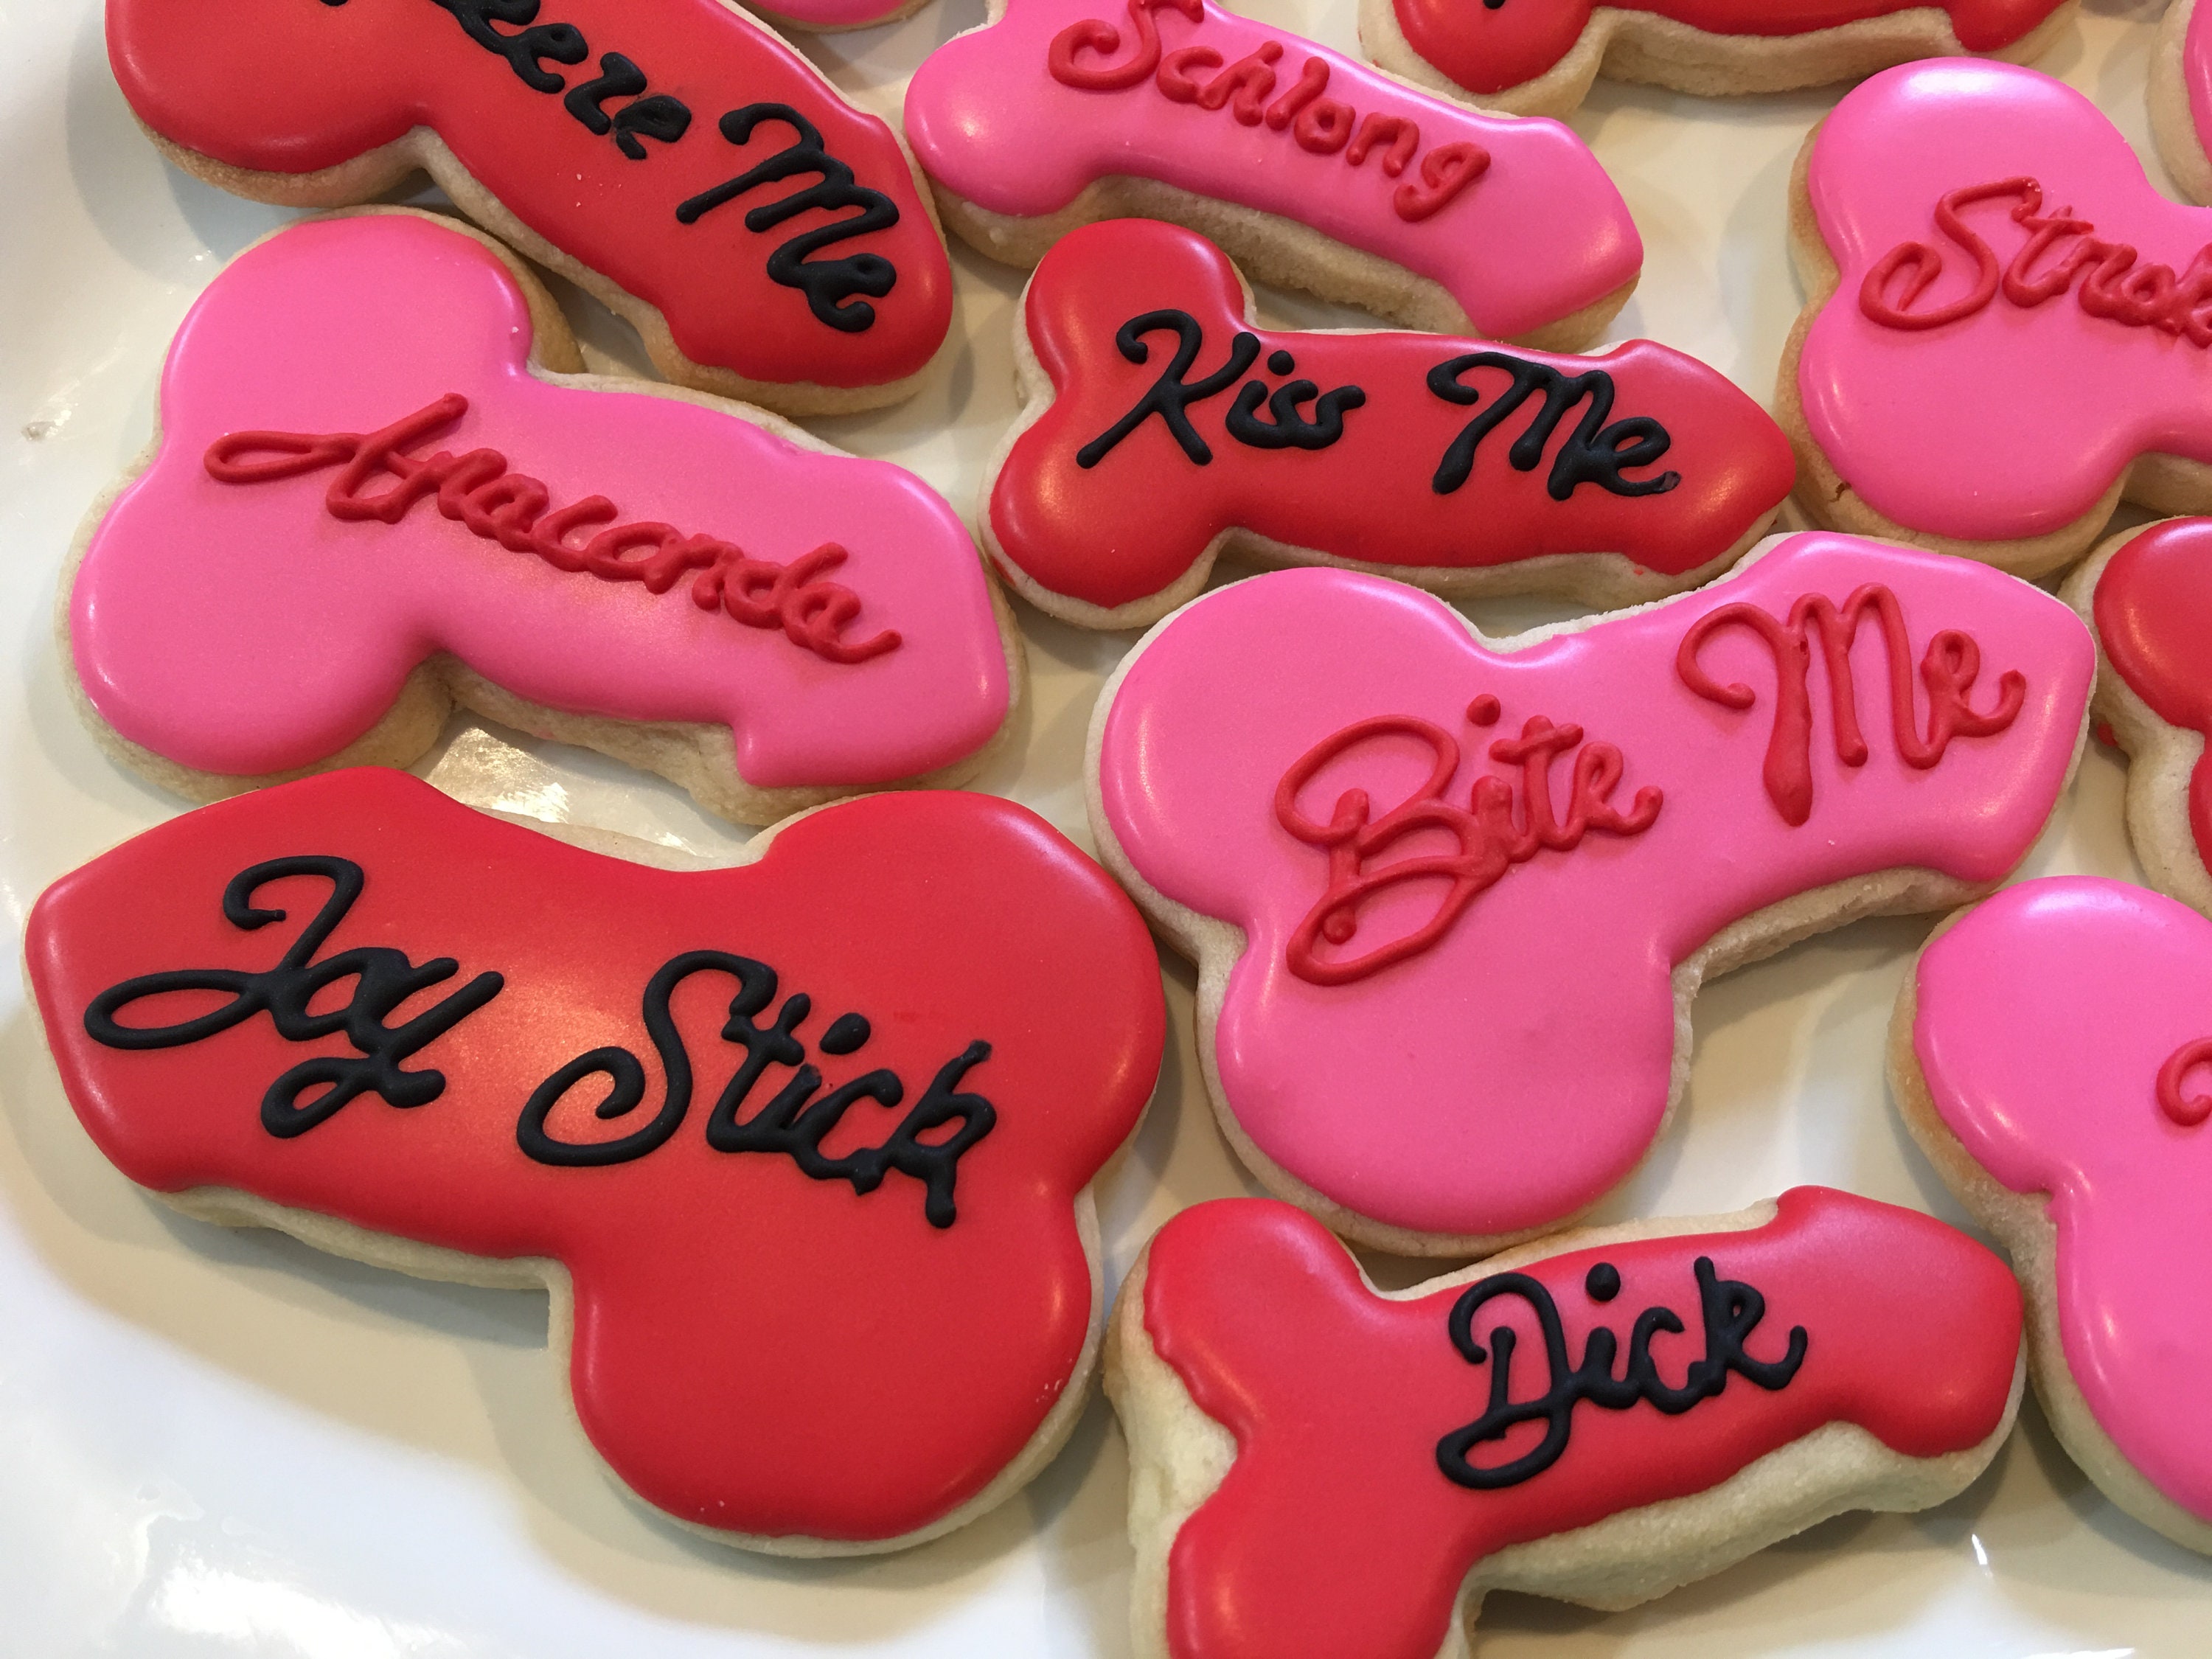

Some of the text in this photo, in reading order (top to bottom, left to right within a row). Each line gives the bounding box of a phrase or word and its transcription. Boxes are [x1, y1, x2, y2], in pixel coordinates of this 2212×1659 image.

[676, 103, 900, 333] Me
[1048, 0, 1491, 223] Schlong
[1077, 310, 1681, 502] Kiss Me
[203, 393, 902, 664] Anaconda
[1275, 583, 2027, 987] Bite Me
[517, 950, 998, 1230] Stick
[1436, 1256, 1809, 1490] Dick
